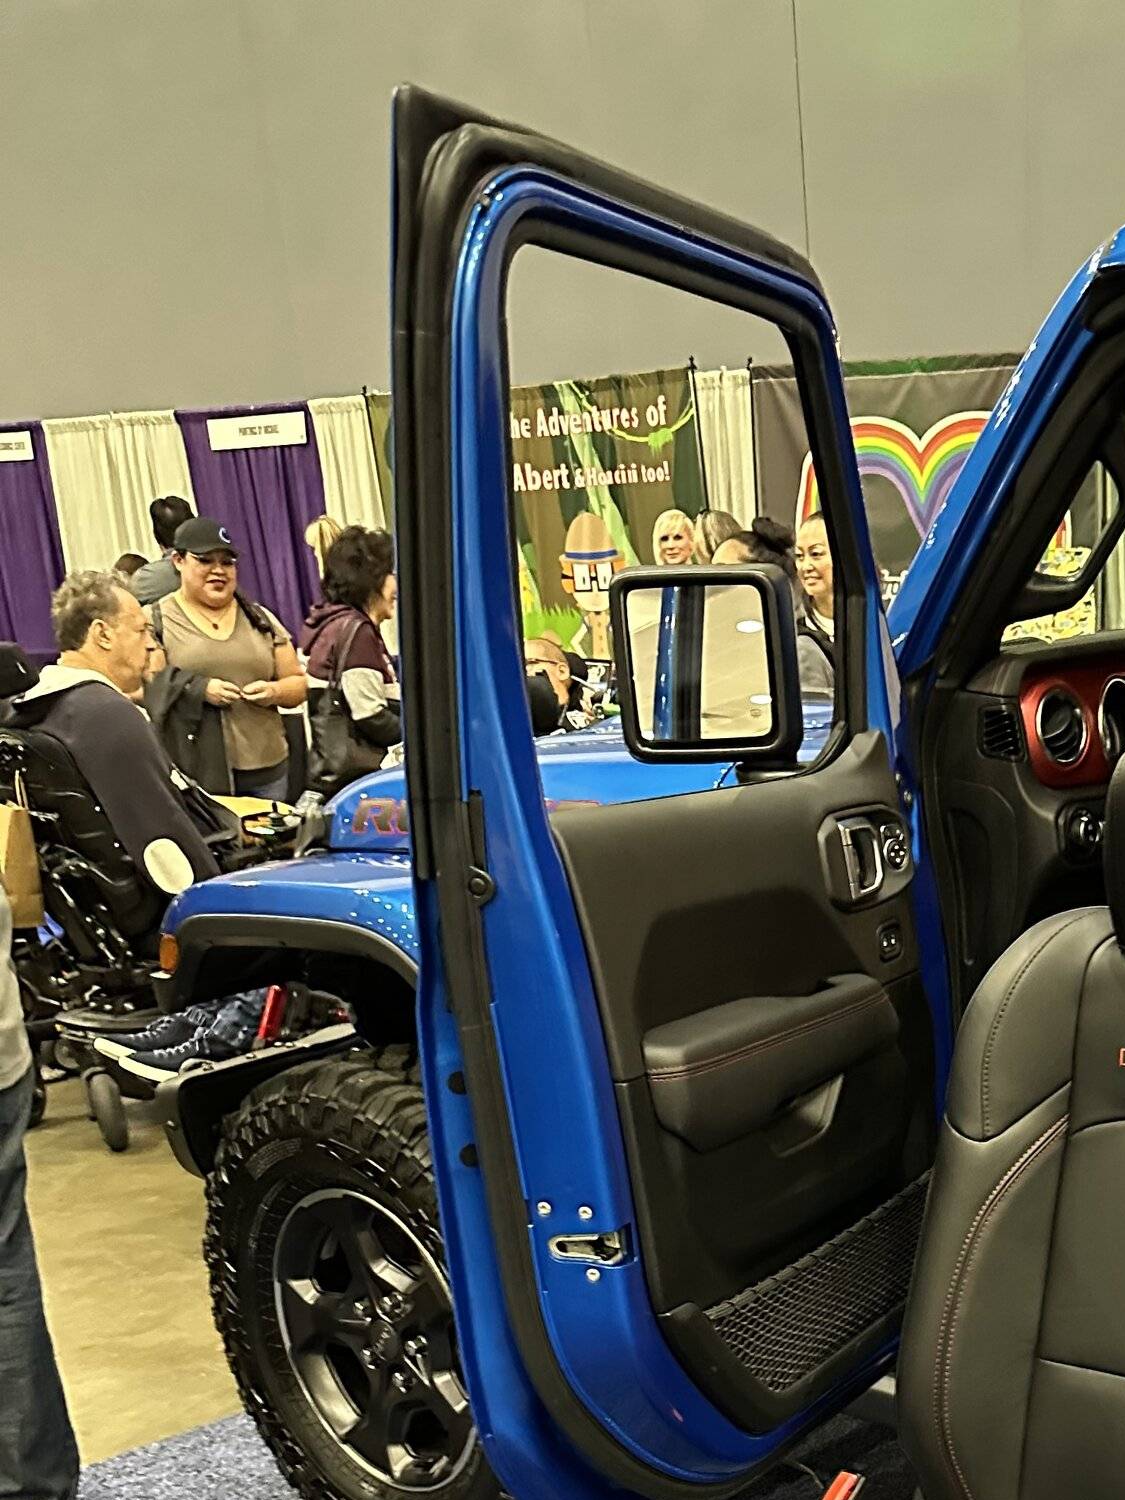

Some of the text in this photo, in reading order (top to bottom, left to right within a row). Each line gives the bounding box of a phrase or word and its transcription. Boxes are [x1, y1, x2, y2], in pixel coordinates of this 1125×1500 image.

[510, 395, 667, 438] he Adventures of
[513, 462, 570, 491] Abert
[574, 468, 586, 489] &
[640, 460, 671, 482] too!
